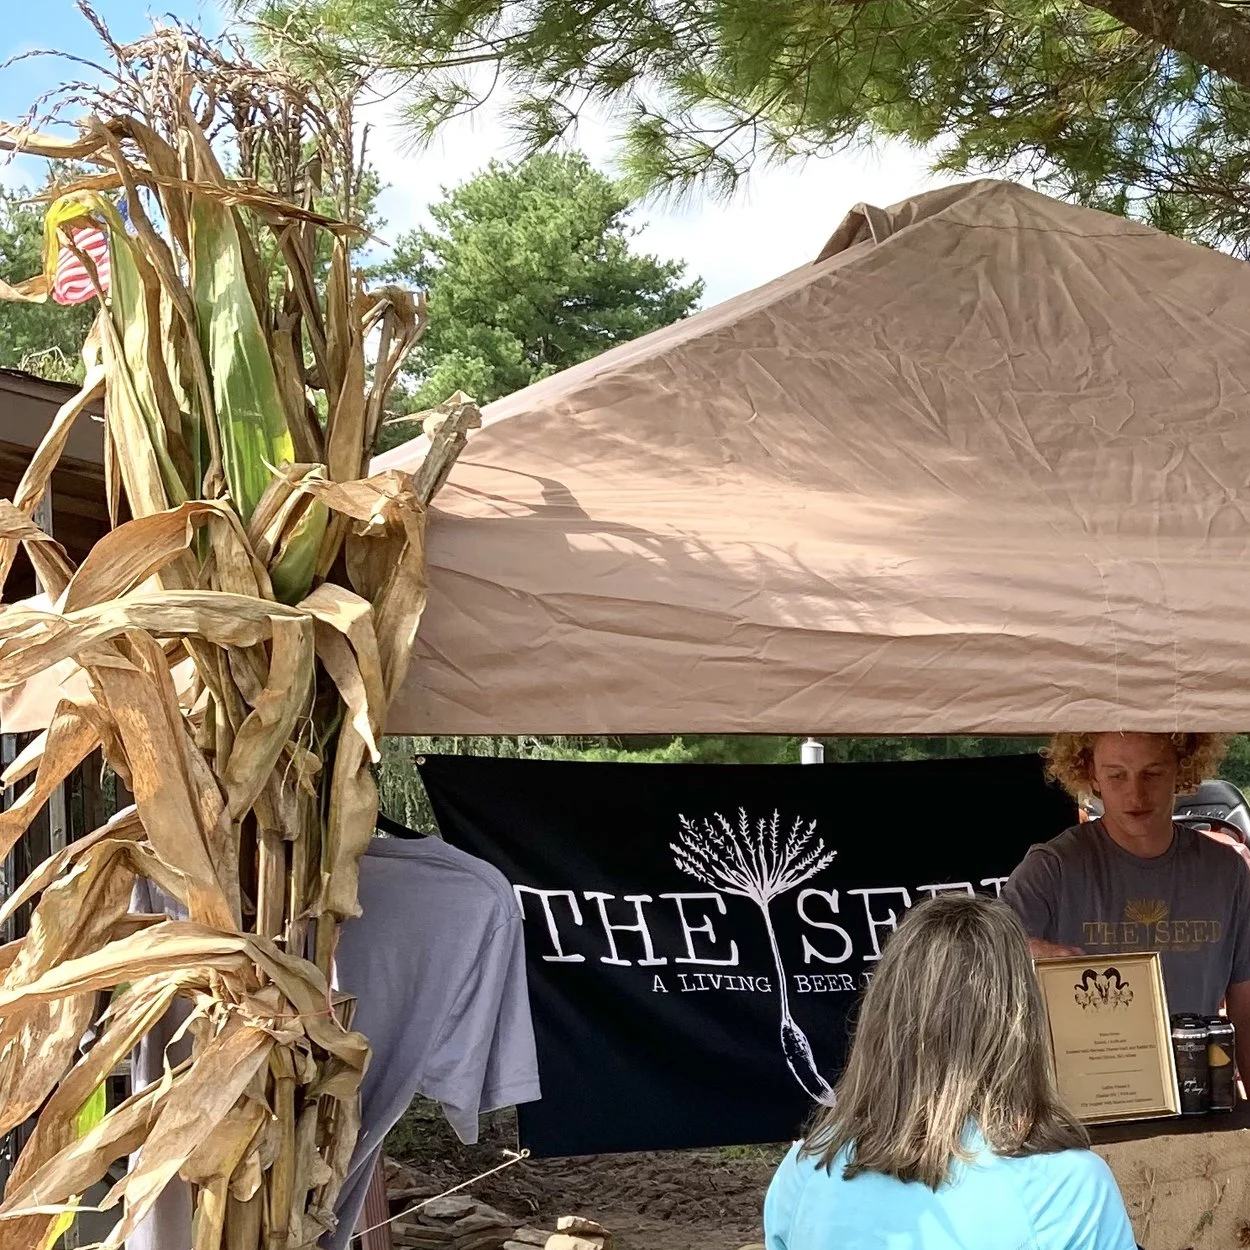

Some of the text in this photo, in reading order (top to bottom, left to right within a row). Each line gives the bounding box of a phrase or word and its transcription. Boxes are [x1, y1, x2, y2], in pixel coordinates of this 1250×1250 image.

[513, 876, 1010, 967] THE SE
[1082, 920, 1222, 945] THE SEED
[651, 974, 669, 993] A
[679, 973, 772, 993] LIVING
[795, 973, 857, 994] BEER
